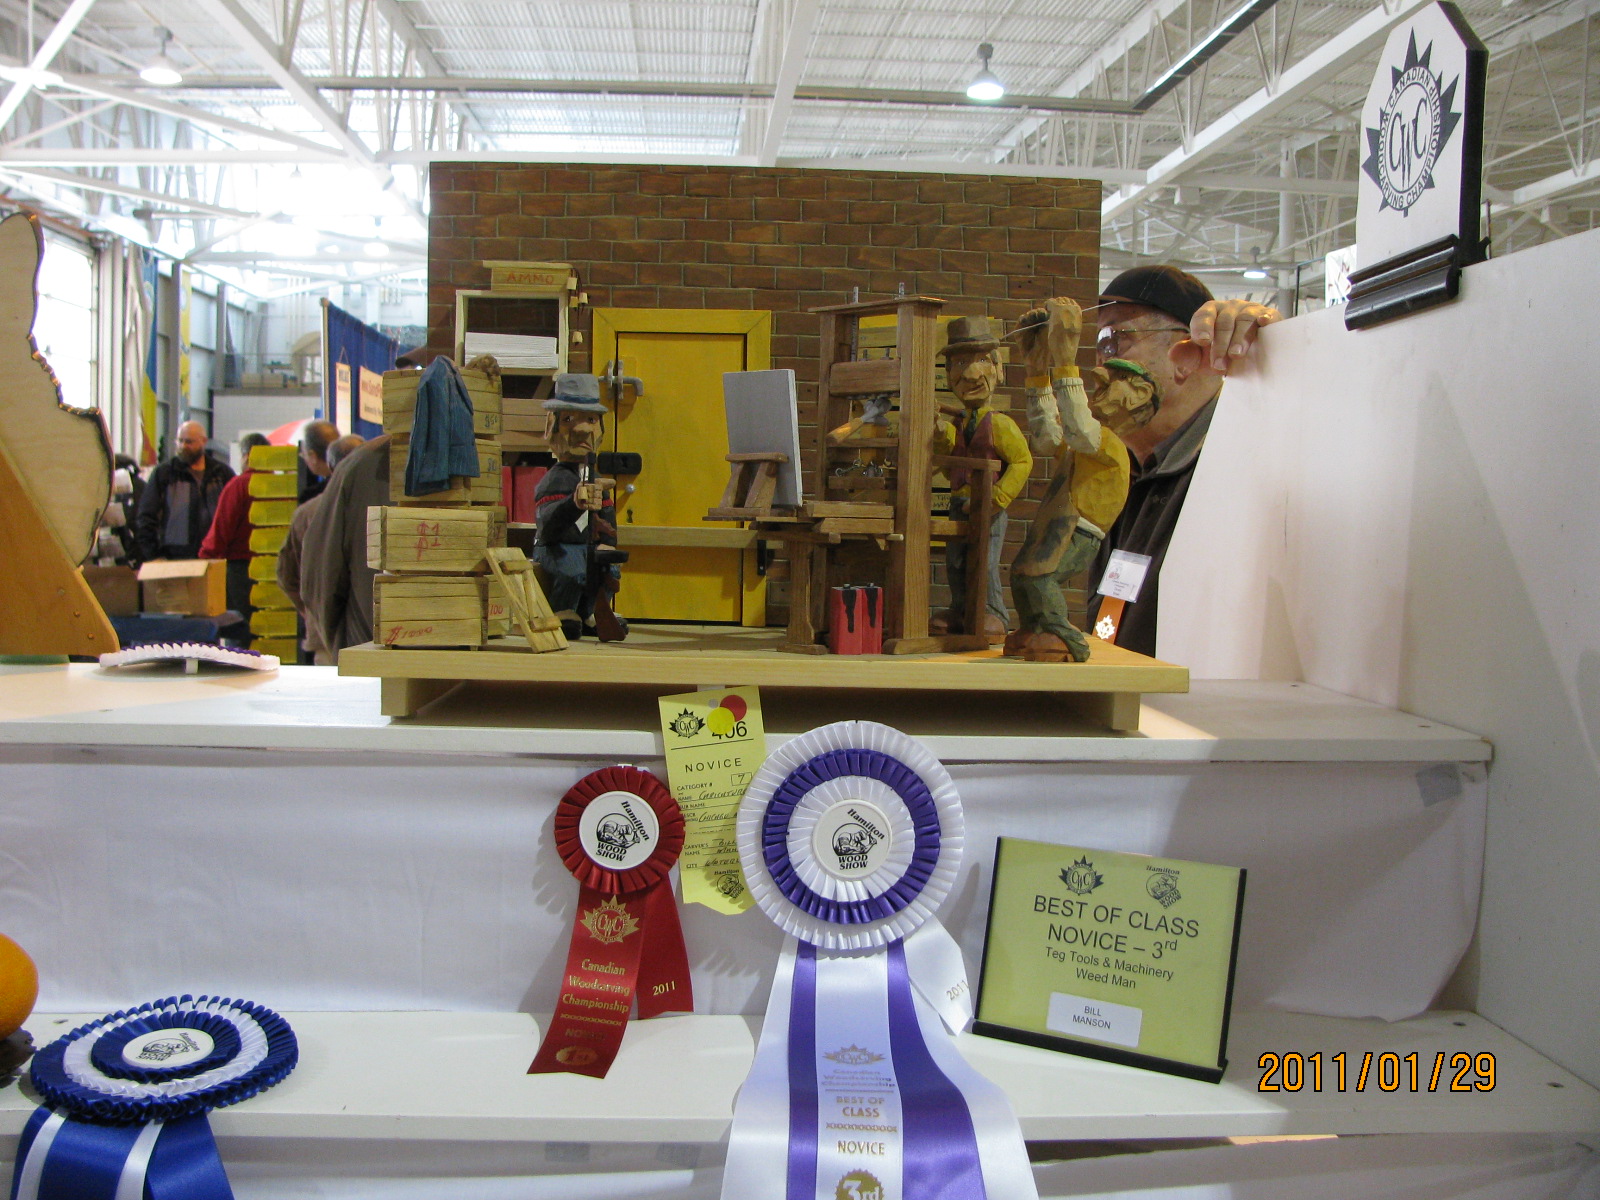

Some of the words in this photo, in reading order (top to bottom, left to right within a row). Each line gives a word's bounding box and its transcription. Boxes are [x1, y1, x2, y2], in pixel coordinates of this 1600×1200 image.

[1388, 67, 1431, 108] CANADIAN
[1377, 111, 1404, 210] WOODCARVING
[1405, 85, 1441, 206] CHAMPIONSHIP
[1389, 97, 1428, 191] CWC
[507, 272, 554, 285] AMMO
[413, 521, 441, 561] $1
[685, 758, 742, 773] NOVICE
[677, 783, 707, 791] CATEGORY
[621, 801, 650, 841] Hamilton
[847, 808, 885, 840] Hamilton
[596, 849, 626, 862] SHOW
[597, 842, 627, 855] WOOD
[838, 854, 868, 863] WOOD
[839, 861, 868, 870] SHOW
[1146, 865, 1180, 875] Hamilton
[1033, 895, 1088, 919] BEST
[1093, 904, 1123, 925] OF
[1128, 910, 1199, 938] CLASS
[1048, 923, 1128, 954] NOVICE
[1151, 939, 1178, 960] 3rd
[581, 958, 626, 976] Canadian
[1045, 946, 1066, 963] Teg
[1070, 951, 1099, 967] Tools
[1102, 958, 1111, 968] &
[1114, 958, 1174, 982] Machinery
[569, 975, 631, 997] Woodcarving
[1076, 967, 1108, 984] Weed
[1111, 974, 1136, 989] Man
[652, 980, 677, 996] 2011
[562, 993, 630, 1014] Championship
[1084, 1005, 1102, 1017] BILL
[1072, 1014, 1111, 1030] MANSON
[836, 1096, 864, 1105] BEST
[867, 1096, 886, 1105] OF
[842, 1107, 881, 1118] CLASS
[837, 1140, 886, 1156] NOVICE
